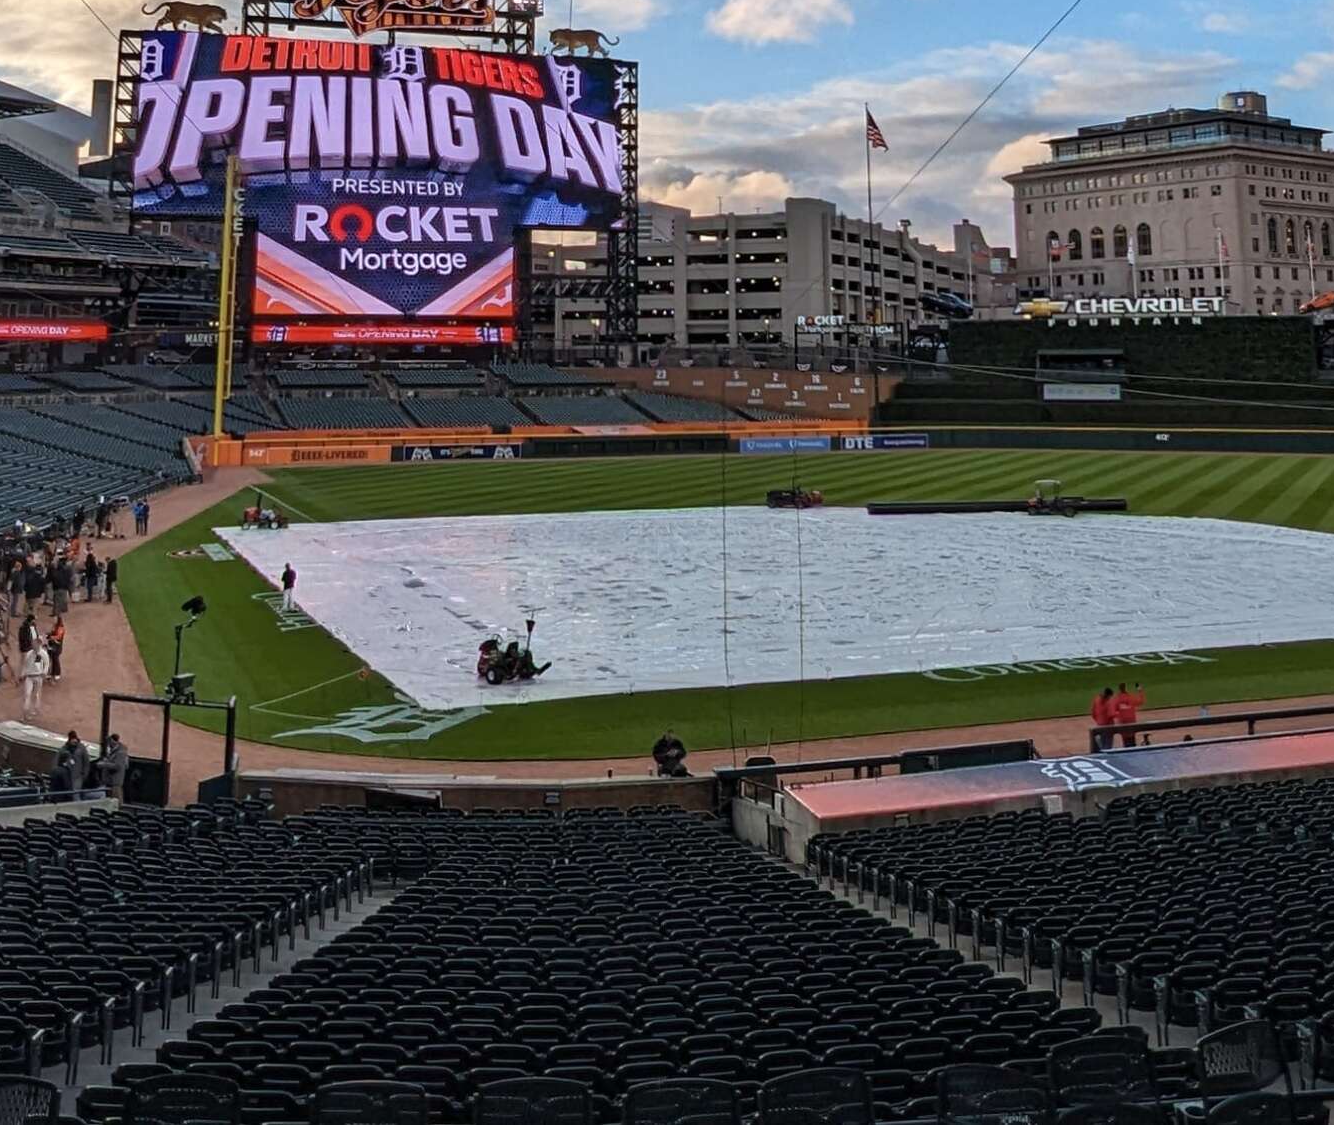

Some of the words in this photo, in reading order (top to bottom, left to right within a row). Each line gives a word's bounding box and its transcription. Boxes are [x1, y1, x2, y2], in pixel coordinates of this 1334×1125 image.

[220, 35, 371, 72] DETROIT
[433, 48, 545, 99] TIGERS
[491, 92, 623, 195] DAY
[332, 178, 439, 195] PRESENTED
[444, 181, 465, 197] BY
[294, 203, 499, 244] ROCKET
[340, 247, 468, 275] Mortgage
[1075, 297, 1225, 314] CHEVROLET
[797, 315, 844, 326] ROCKET
[1047, 317, 1203, 327] FOUNTAIN
[49, 326, 70, 337] DAY
[845, 436, 874, 450] DTE
